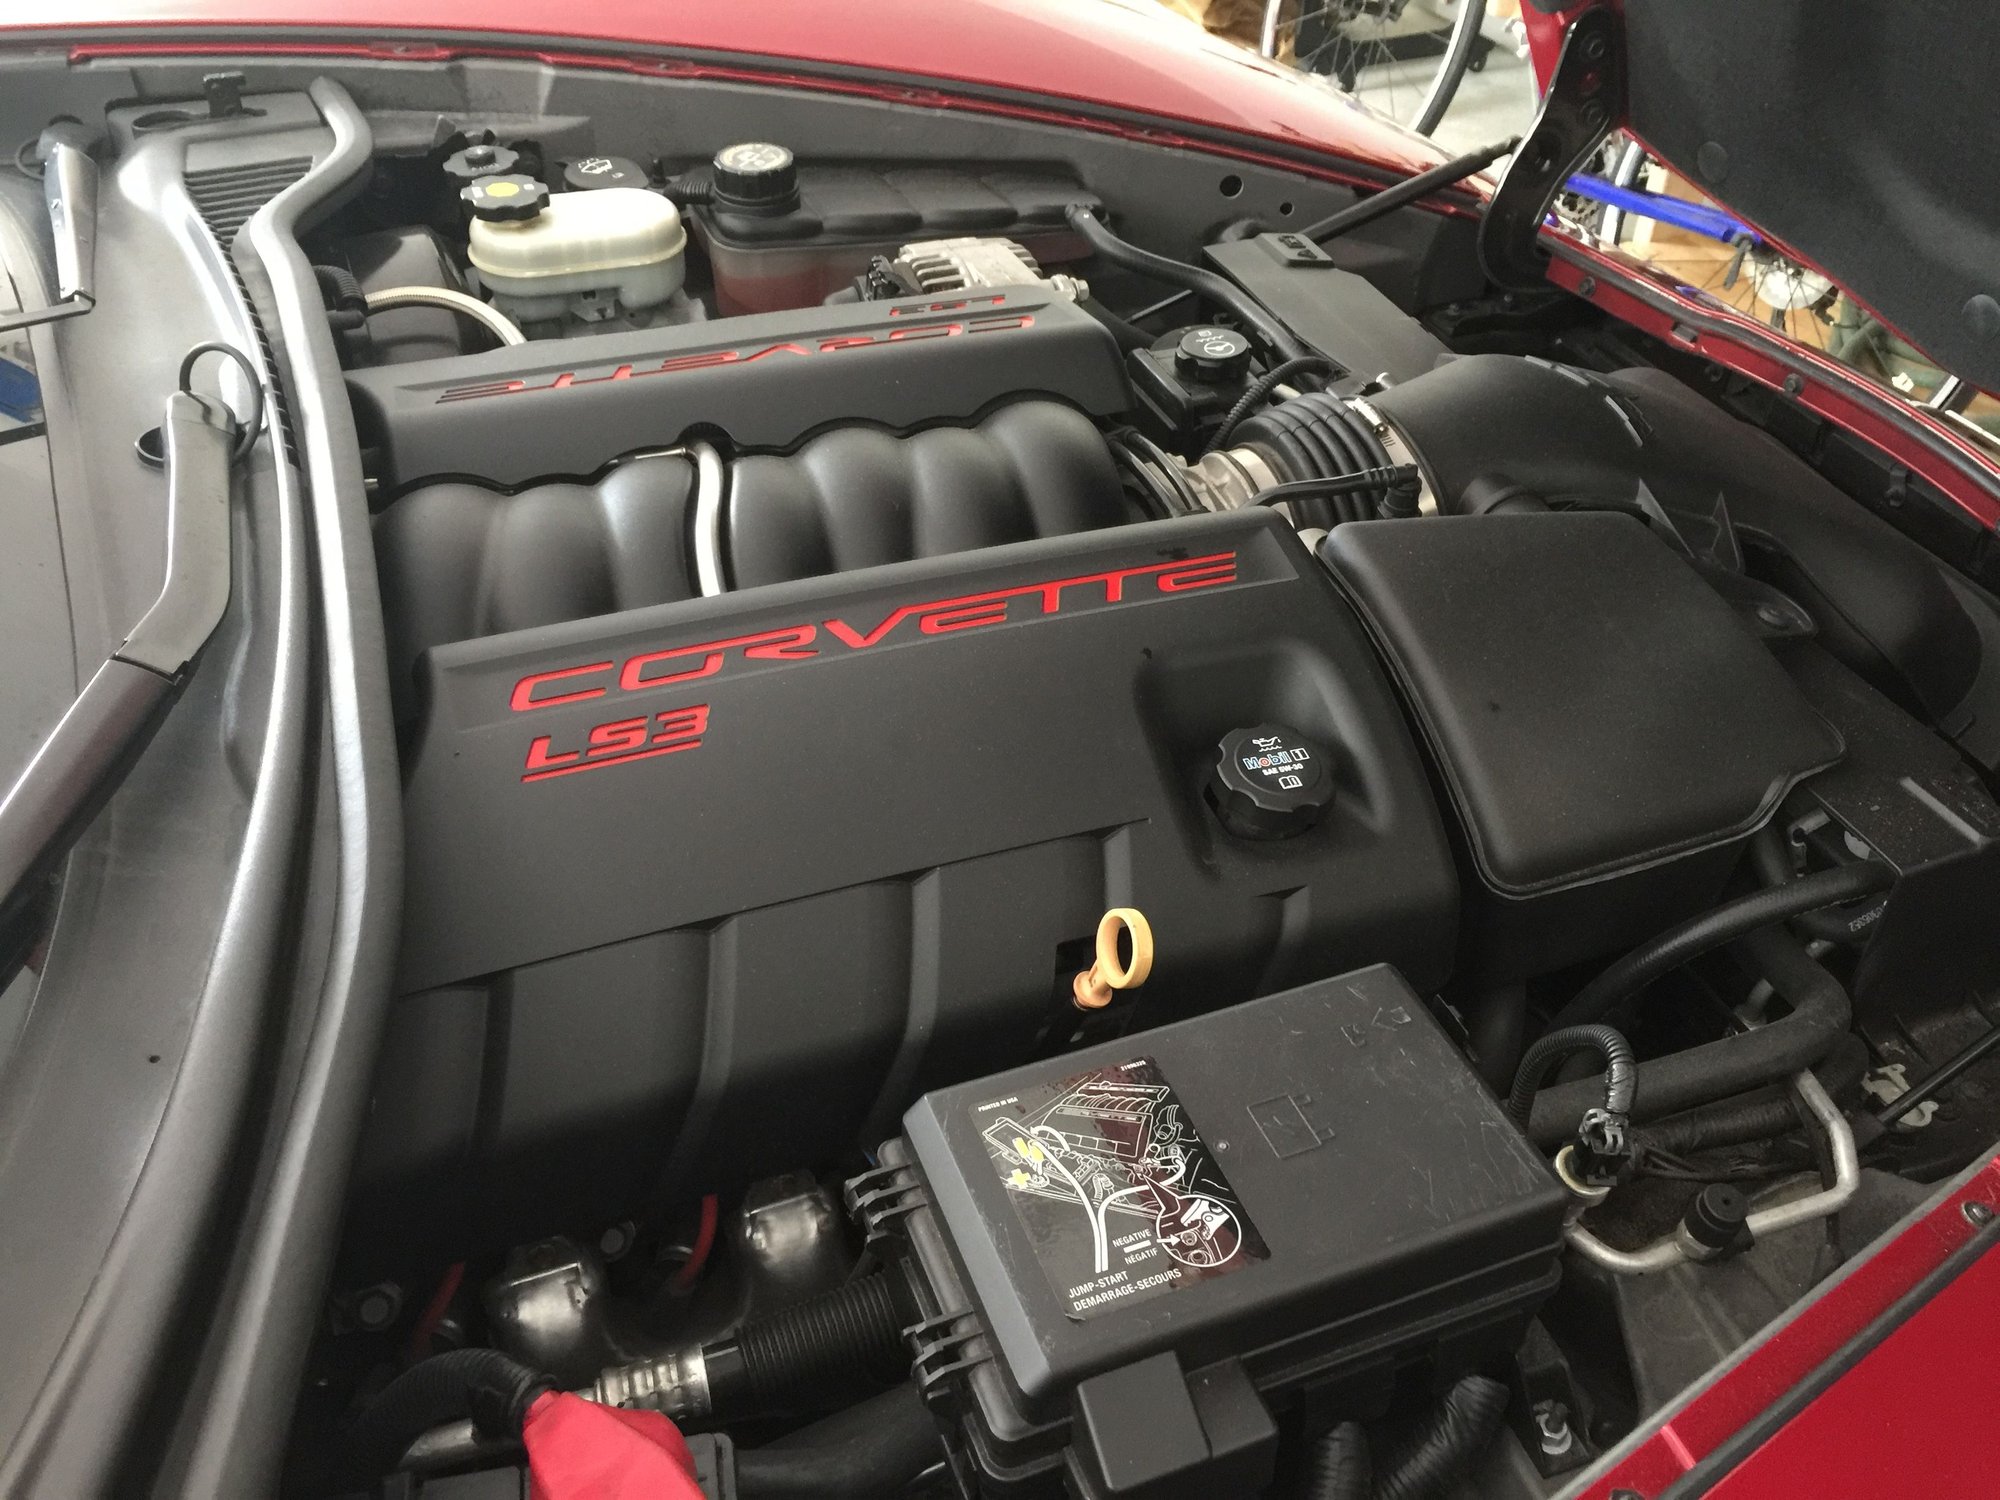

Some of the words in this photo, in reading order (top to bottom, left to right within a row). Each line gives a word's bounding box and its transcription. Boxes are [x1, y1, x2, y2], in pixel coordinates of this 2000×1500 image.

[436, 314, 1035, 404] CORVETTE
[509, 551, 1237, 711] CORVETTE
[522, 703, 710, 771] LS3
[1243, 751, 1292, 770] Mobil
[1262, 767, 1278, 775] SAE
[1279, 764, 1303, 772] 5W-30
[978, 1101, 1000, 1112] PRINTED
[1000, 1099, 1008, 1108] IN
[1007, 1096, 1019, 1106] USA
[1112, 1228, 1152, 1248] NEGATIVE
[1068, 1270, 1129, 1299] JUMP-START
[1073, 1267, 1182, 1312] DEMARRAGE-SECOURS
